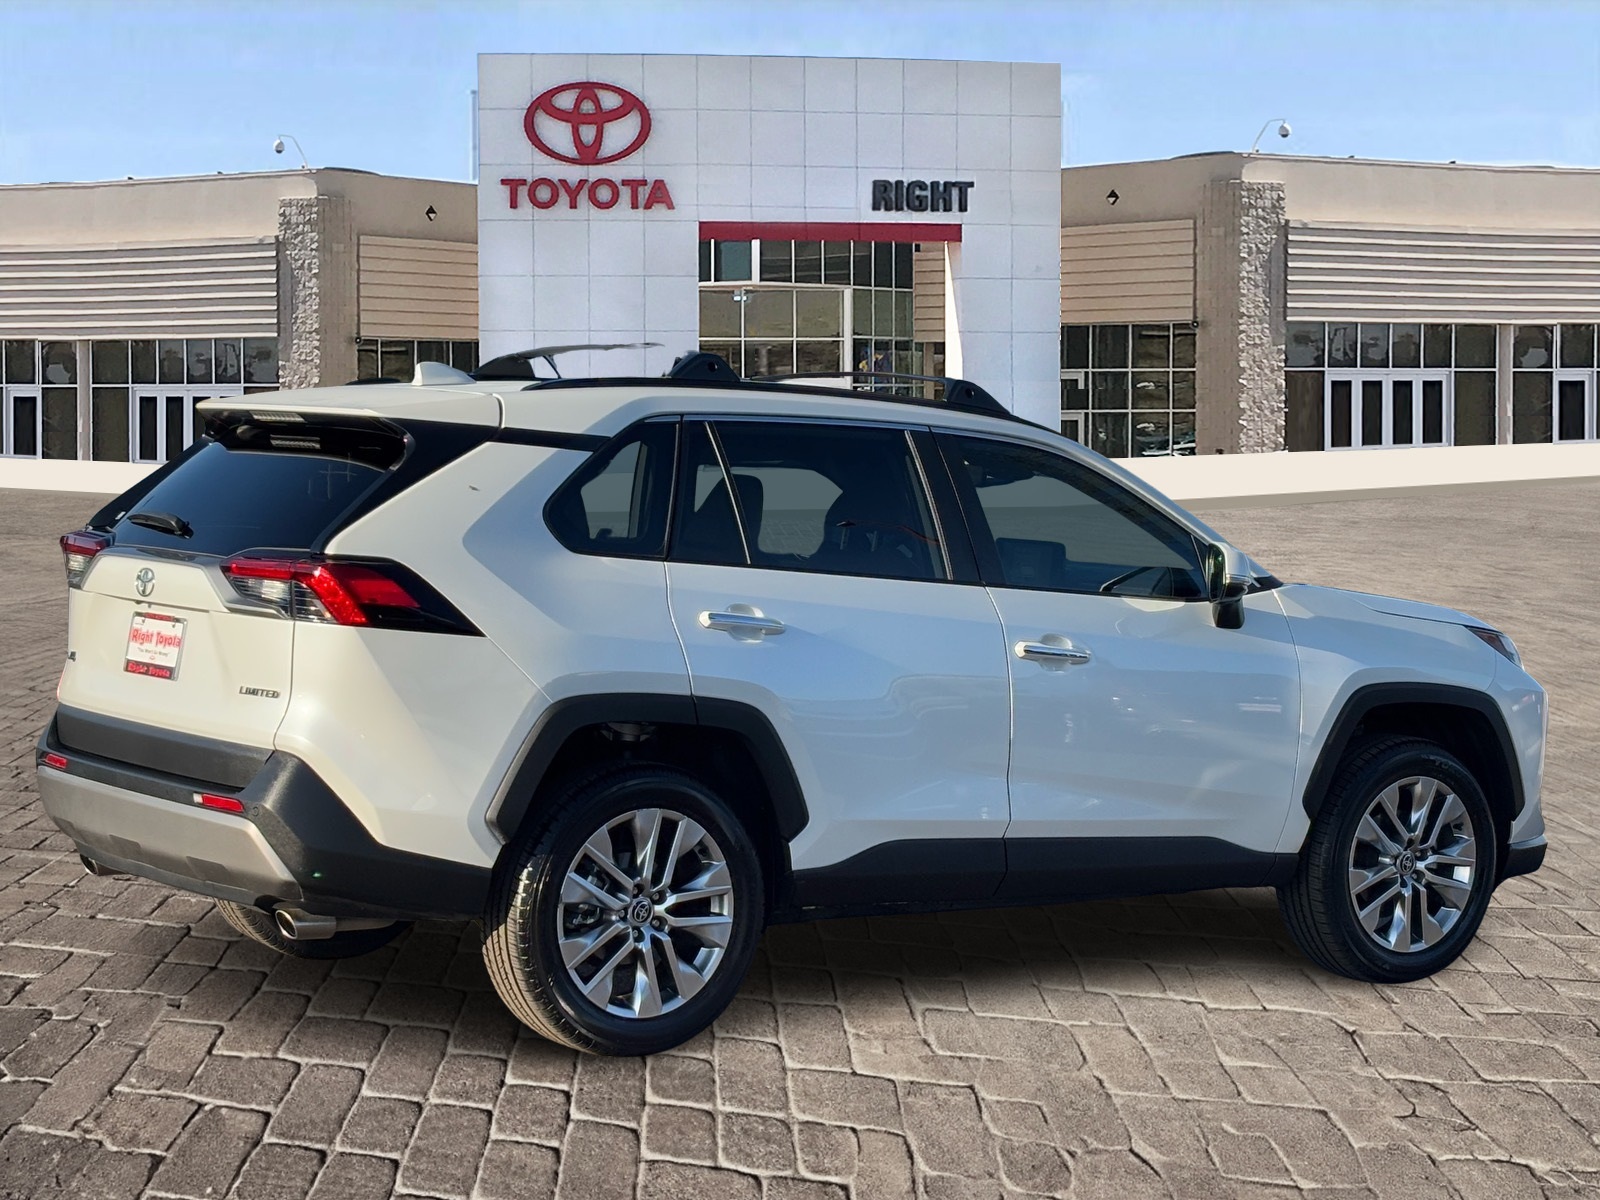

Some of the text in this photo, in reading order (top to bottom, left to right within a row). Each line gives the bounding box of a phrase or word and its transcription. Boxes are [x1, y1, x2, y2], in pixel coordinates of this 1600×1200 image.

[500, 178, 675, 209] TOYOTA
[872, 179, 974, 212] RIGHT
[132, 628, 182, 648] Right Toyota
[239, 686, 280, 698] LIMITED
